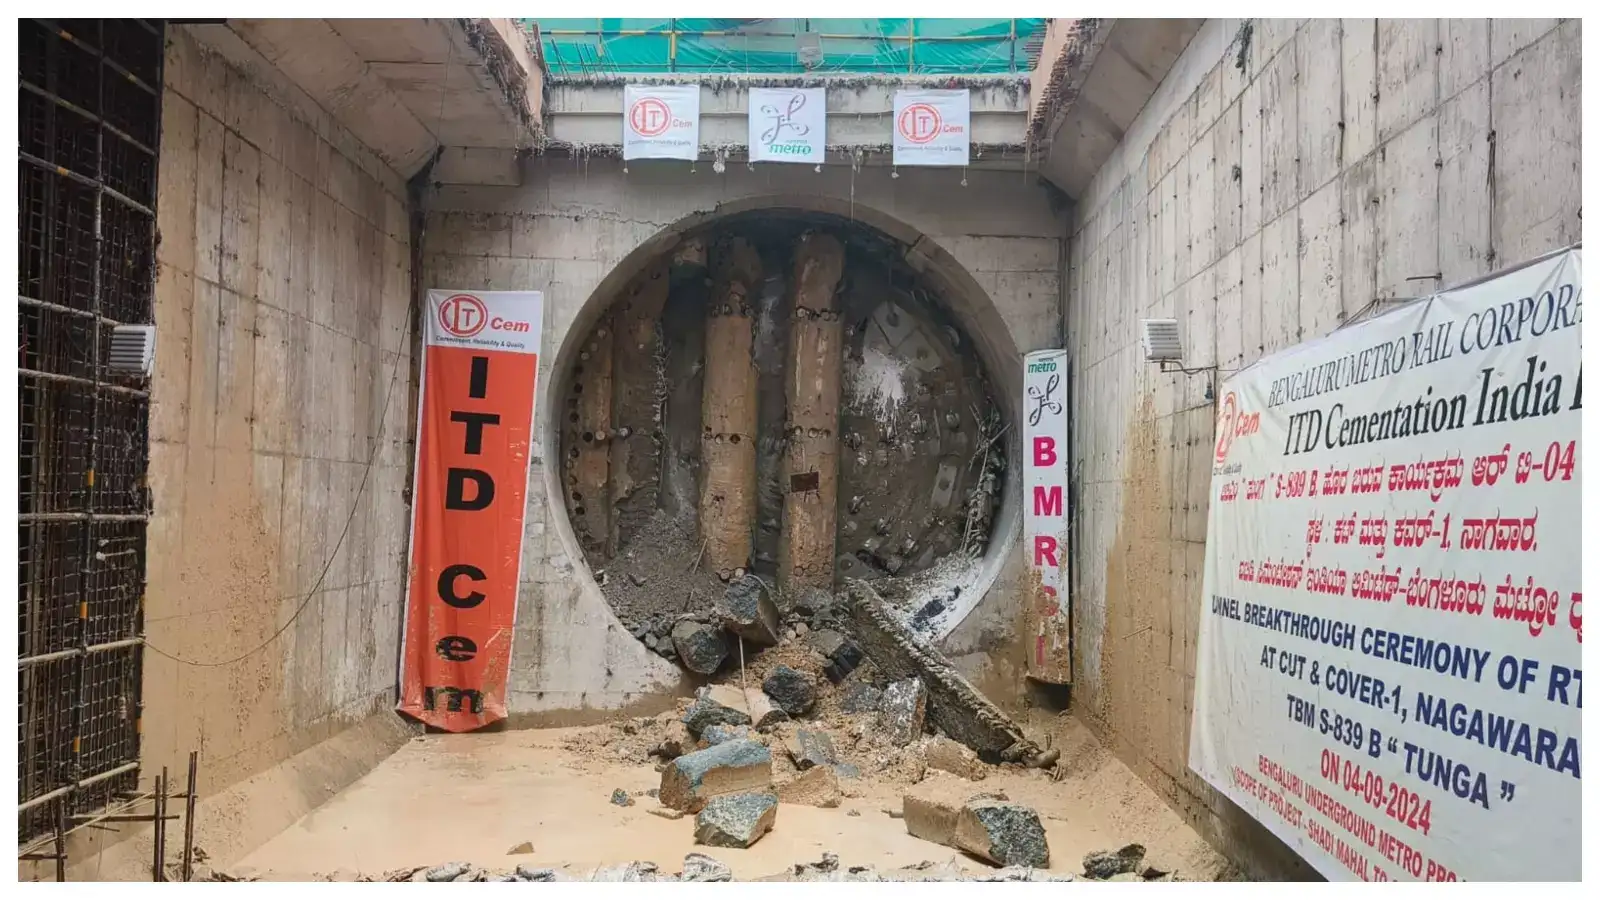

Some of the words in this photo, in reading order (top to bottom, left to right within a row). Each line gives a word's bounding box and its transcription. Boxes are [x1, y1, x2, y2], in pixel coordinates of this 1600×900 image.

[672, 118, 693, 129] Cem
[769, 144, 812, 155] metro
[943, 124, 964, 134] Cem
[491, 316, 530, 333] Cem
[1028, 362, 1057, 374] metro
[1268, 354, 1345, 408] BENGALURU
[1344, 336, 1407, 388] METRO
[1410, 320, 1454, 370] RAIL
[445, 355, 500, 511] ITD
[1283, 407, 1323, 456] ITD
[1325, 385, 1466, 449] Cementation
[1472, 355, 1563, 426] India
[1275, 468, 1307, 499] S-839
[1243, 602, 1357, 651] BREAKTHROUGH
[1360, 627, 1491, 683] CEREMONY
[1498, 655, 1539, 693] OF
[1260, 645, 1279, 669] AT
[1279, 651, 1306, 682] CUT
[1309, 661, 1320, 684] &
[1325, 665, 1408, 723] COVER-1,
[1415, 691, 1581, 779] NAGAWARA
[1287, 694, 1315, 729] TBM
[1319, 709, 1363, 750] S-839
[1368, 728, 1381, 759] B
[1404, 742, 1490, 809] TUNGA
[1257, 782, 1268, 802] OF
[1268, 790, 1303, 829] PROJECT
[1308, 819, 1334, 852] SHADI
[1336, 838, 1369, 882] MAHAL
[1258, 754, 1302, 798] BENGALURU
[1304, 784, 1376, 847] UNDERGROUND
[1378, 829, 1423, 877] METRO
[1320, 748, 1339, 785] ON
[1342, 760, 1432, 836] 04-09-2024
